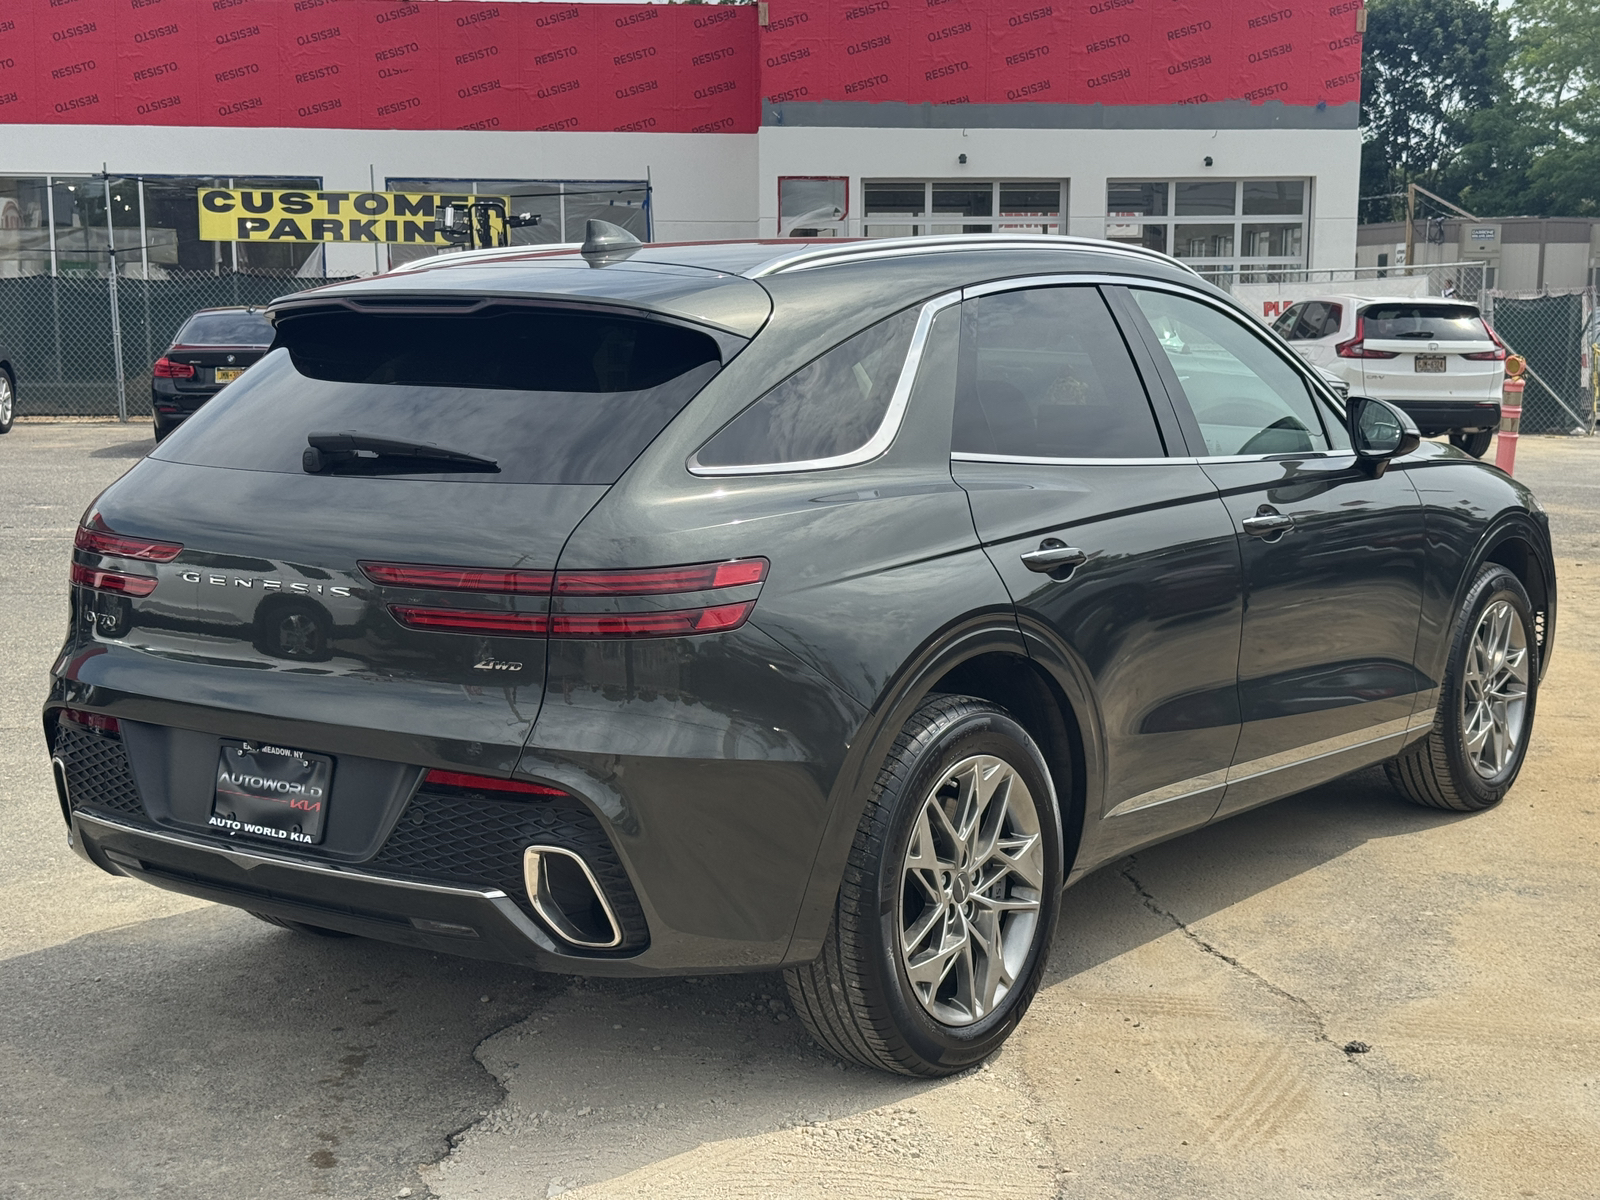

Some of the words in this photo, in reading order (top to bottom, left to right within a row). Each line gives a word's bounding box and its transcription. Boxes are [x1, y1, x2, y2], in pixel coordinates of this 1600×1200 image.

[376, 4, 420, 24] RESISTO
[456, 8, 500, 27] RESISTO
[535, 8, 579, 28] RESISTO
[615, 9, 658, 28] RESISTO
[694, 9, 737, 28] RESISTO
[846, 1, 890, 21] RESISTO
[1008, 7, 1053, 27] RESISTO
[1248, 9, 1292, 29] RESISTO
[53, 22, 96, 42] RESISTO
[134, 24, 178, 43] RESISTO
[216, 26, 260, 45] RESISTO
[297, 27, 340, 46] RESISTO
[928, 22, 972, 42] RESISTO
[1167, 21, 1211, 41] RESISTO
[375, 43, 419, 62] RESISTO
[847, 35, 891, 55] RESISTO
[1086, 34, 1130, 54] RESISTO
[1248, 44, 1293, 63] RESISTO
[456, 46, 498, 65] RESISTO
[534, 46, 577, 66] RESISTO
[613, 47, 656, 66] RESISTO
[692, 48, 734, 67] RESISTO
[767, 48, 810, 68] RESISTO
[1006, 46, 1050, 66] RESISTO
[1168, 55, 1212, 75] RESISTO
[52, 60, 96, 79] RESISTO
[133, 62, 178, 81] RESISTO
[215, 64, 259, 83] RESISTO
[295, 65, 339, 84] RESISTO
[925, 61, 969, 81] RESISTO
[1087, 69, 1131, 88] RESISTO
[458, 80, 500, 99] RESISTO
[537, 80, 579, 99] RESISTO
[615, 80, 658, 99] RESISTO
[845, 74, 889, 94] RESISTO
[1007, 80, 1051, 100] RESISTO
[1325, 71, 1361, 90] RESIST
[693, 81, 736, 100] RESISTO
[768, 86, 809, 104] ESISTO
[1244, 82, 1289, 101] RESISTO
[55, 94, 99, 113] RESISTO
[137, 96, 181, 115] RESISTO
[218, 98, 262, 117] RESISTO
[298, 99, 342, 117] RESISTO
[375, 97, 420, 117] RESISTO
[181, 571, 352, 597] GENESIS
[293, 750, 304, 759] NY
[219, 771, 323, 798] AUTOWORLD
[208, 816, 241, 830] AUTO
[244, 823, 287, 839] WORLD
[290, 832, 313, 844] KIA
